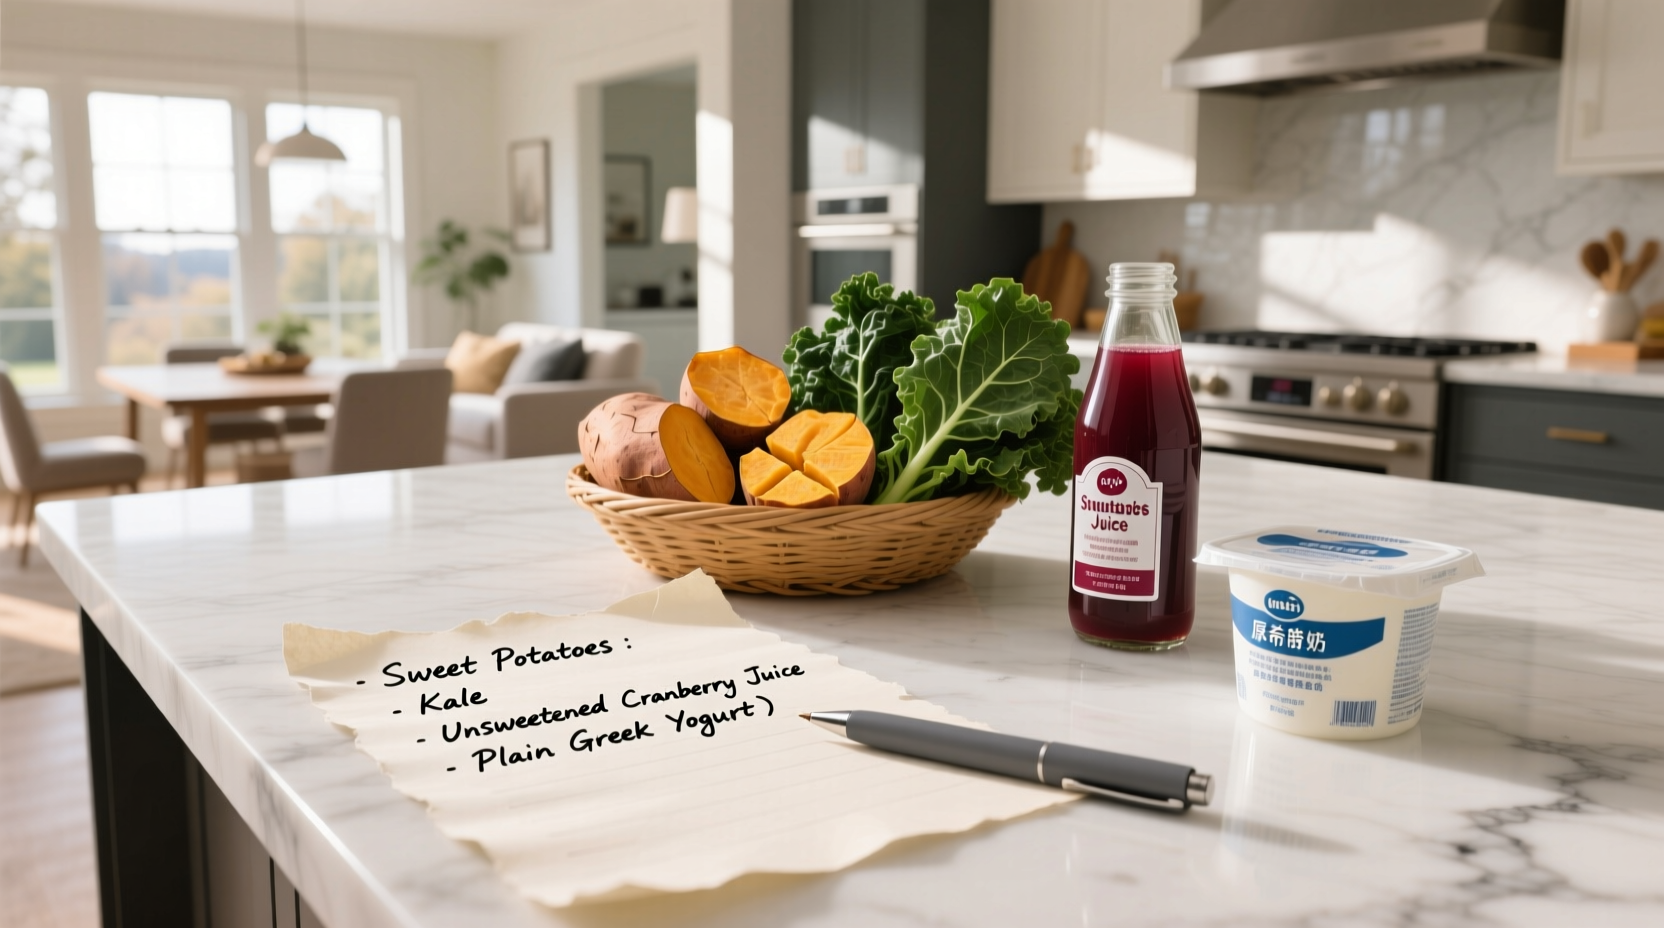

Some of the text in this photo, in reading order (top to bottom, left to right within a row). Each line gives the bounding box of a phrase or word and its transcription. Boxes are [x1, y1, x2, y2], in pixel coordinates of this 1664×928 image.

[1091, 513, 1128, 532] Juice
[382, 655, 478, 687] Sweet
[420, 687, 488, 715] Kale
[442, 693, 609, 743] Unsweetened
[621, 679, 737, 708] Cranberry
[743, 664, 805, 686] Juice
[471, 743, 556, 773] Plain
[569, 720, 655, 752] Greek
[664, 695, 774, 738] Yogurt)
